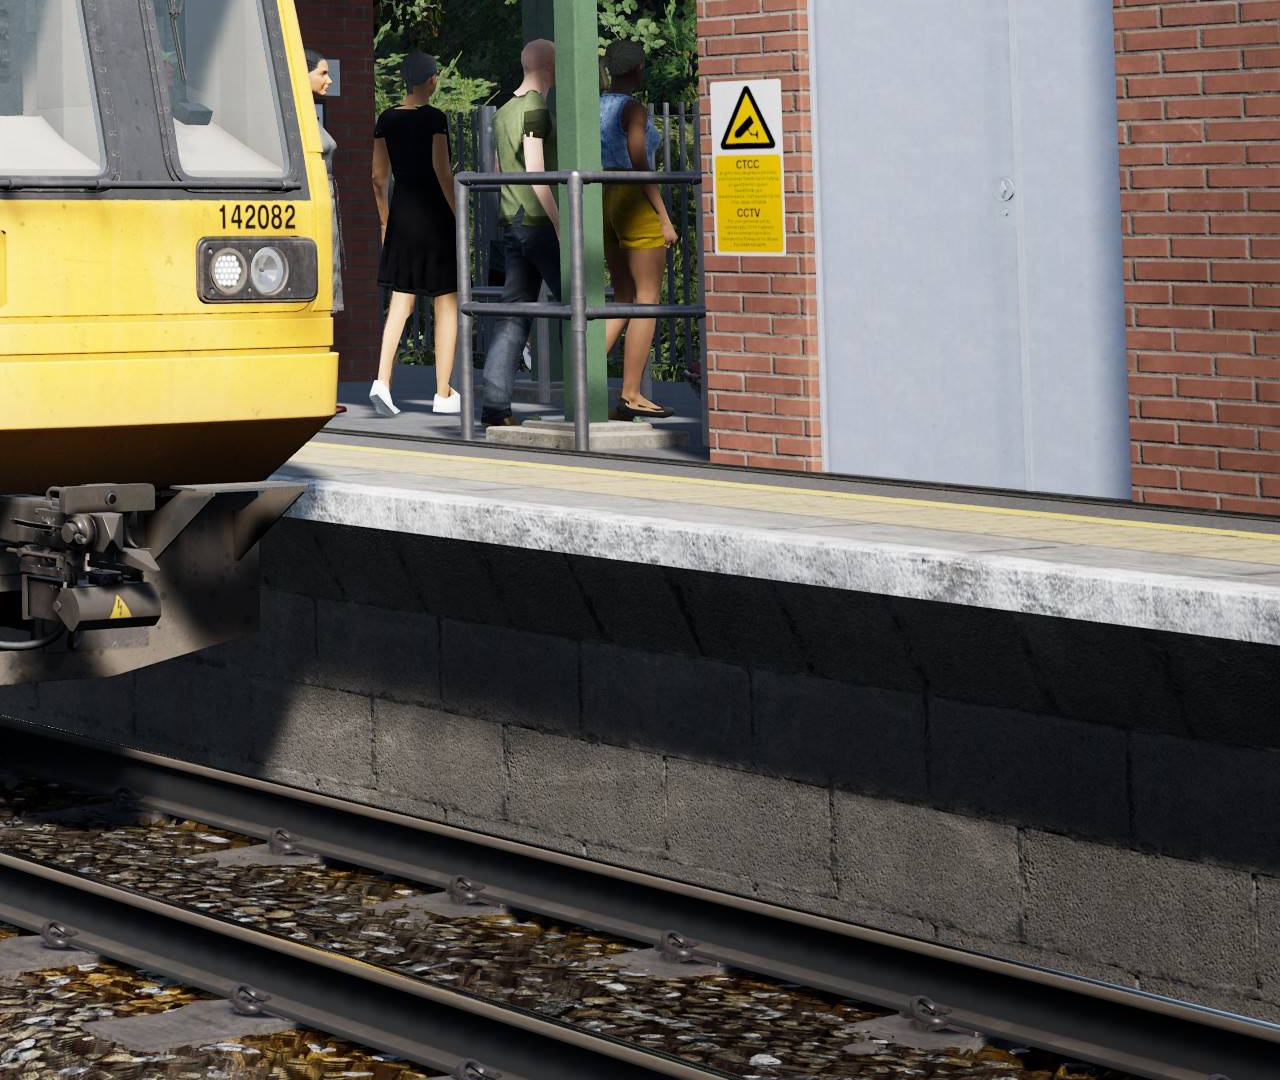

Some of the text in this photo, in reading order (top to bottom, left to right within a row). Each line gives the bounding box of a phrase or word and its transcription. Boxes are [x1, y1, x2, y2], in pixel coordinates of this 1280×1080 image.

[736, 159, 760, 169] CTCC
[219, 204, 296, 229] 142082
[736, 208, 760, 218] CCTV
